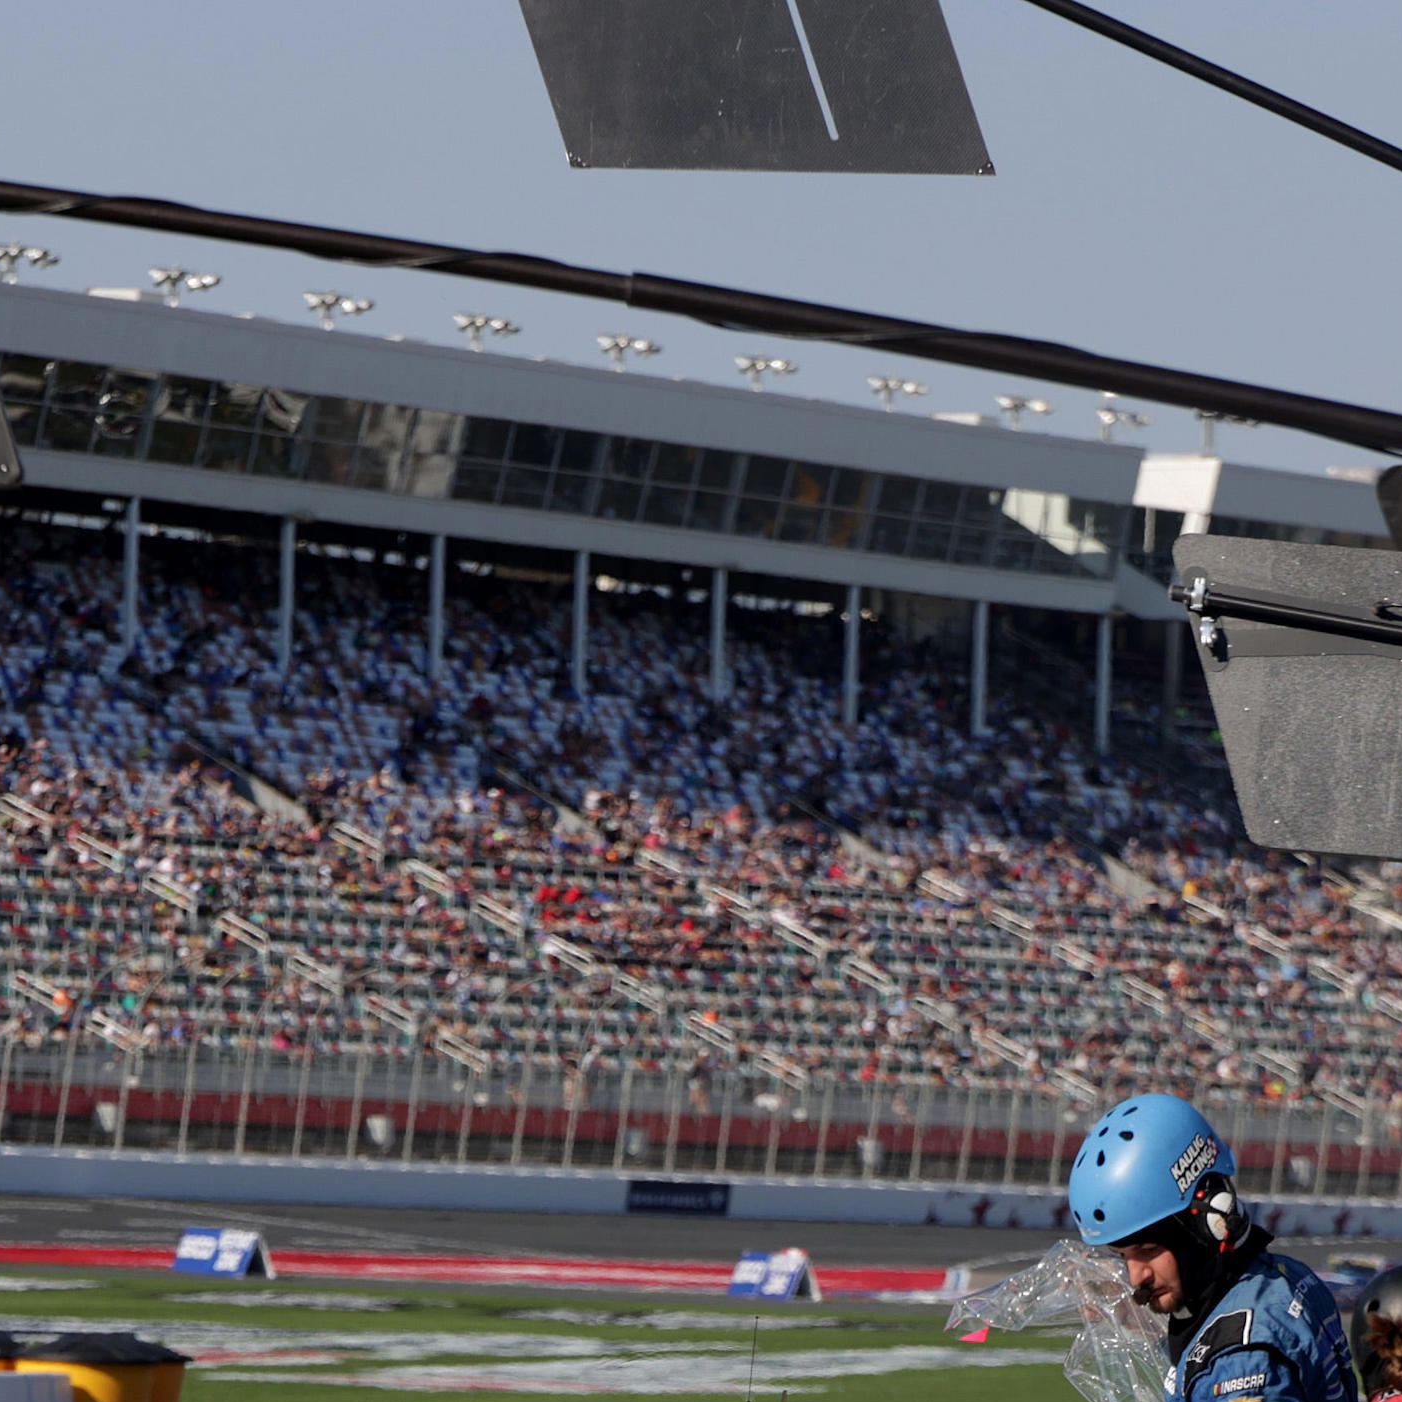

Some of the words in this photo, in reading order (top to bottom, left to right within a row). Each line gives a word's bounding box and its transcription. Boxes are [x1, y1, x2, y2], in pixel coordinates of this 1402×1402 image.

[1171, 1134, 1204, 1180] KAULIG
[1178, 1145, 1212, 1193] RACING
[1218, 1374, 1266, 1394] NASCAR
